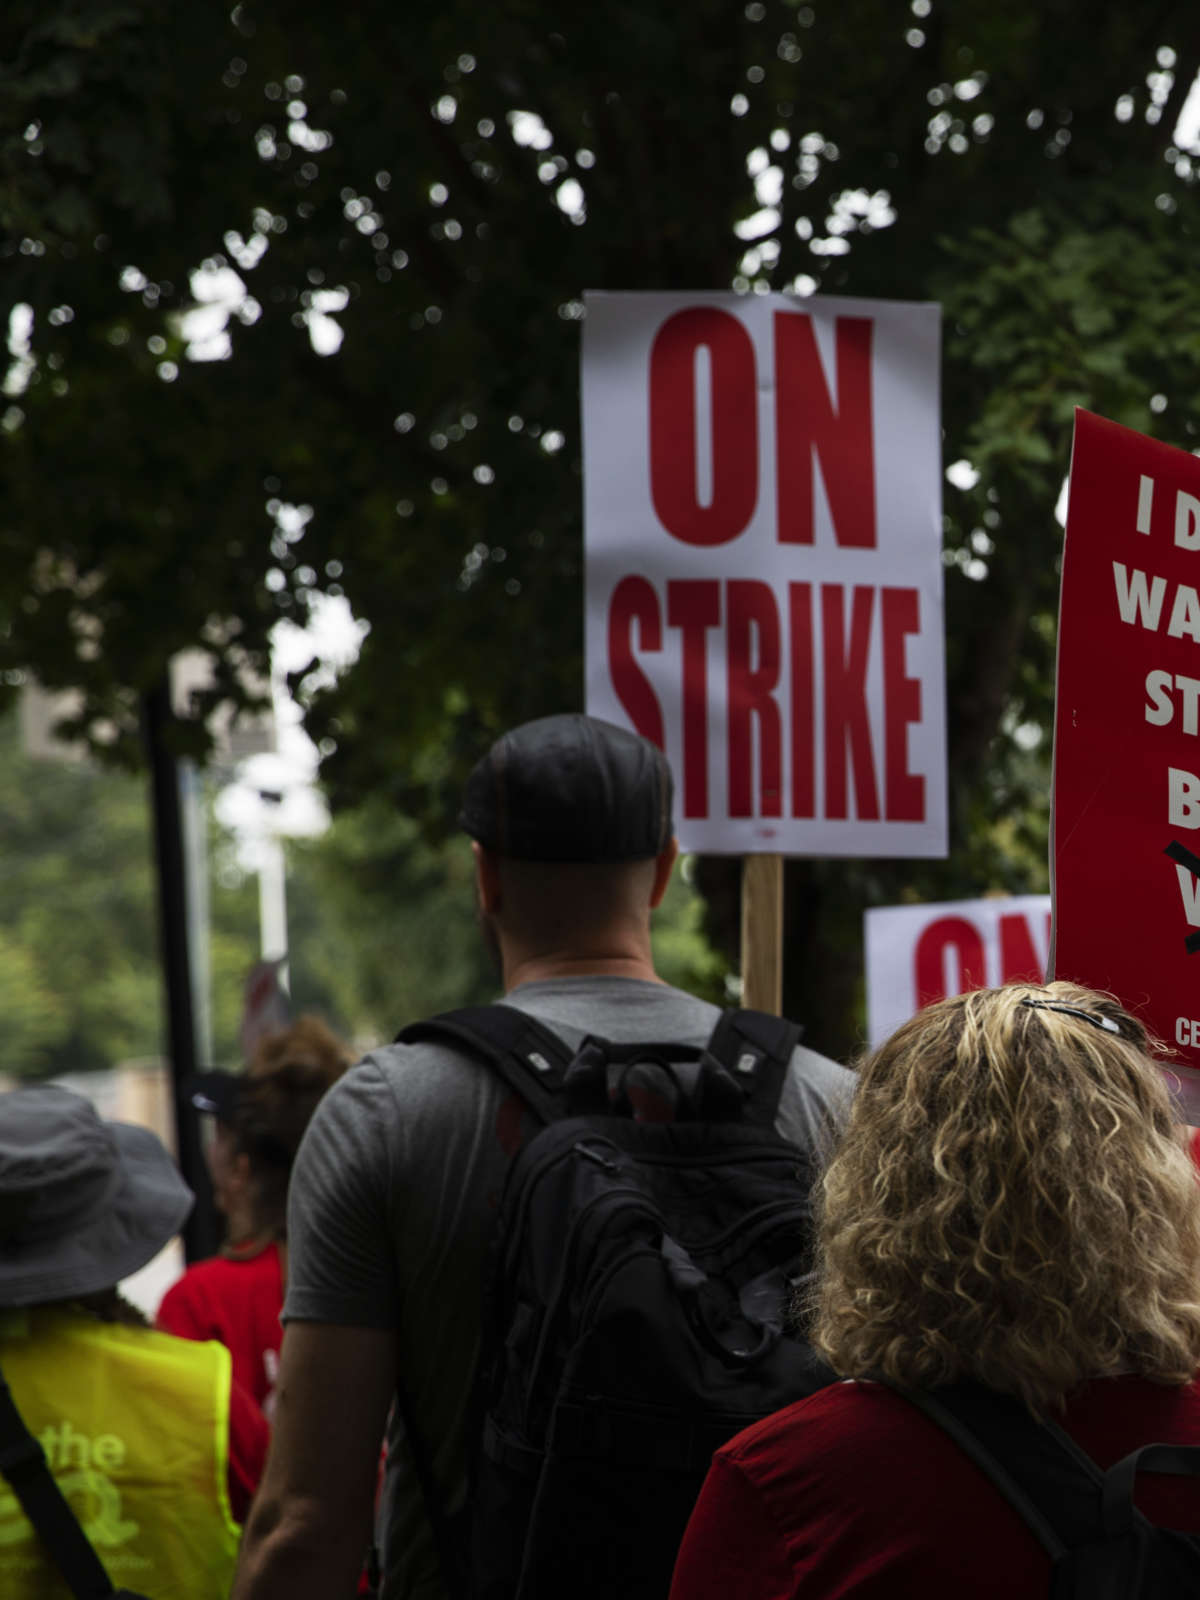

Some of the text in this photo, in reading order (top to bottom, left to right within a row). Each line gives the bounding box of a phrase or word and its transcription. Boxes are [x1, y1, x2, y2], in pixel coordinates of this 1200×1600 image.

[648, 306, 877, 550] ON
[1136, 474, 1154, 535] I
[607, 575, 926, 822] STRIKE
